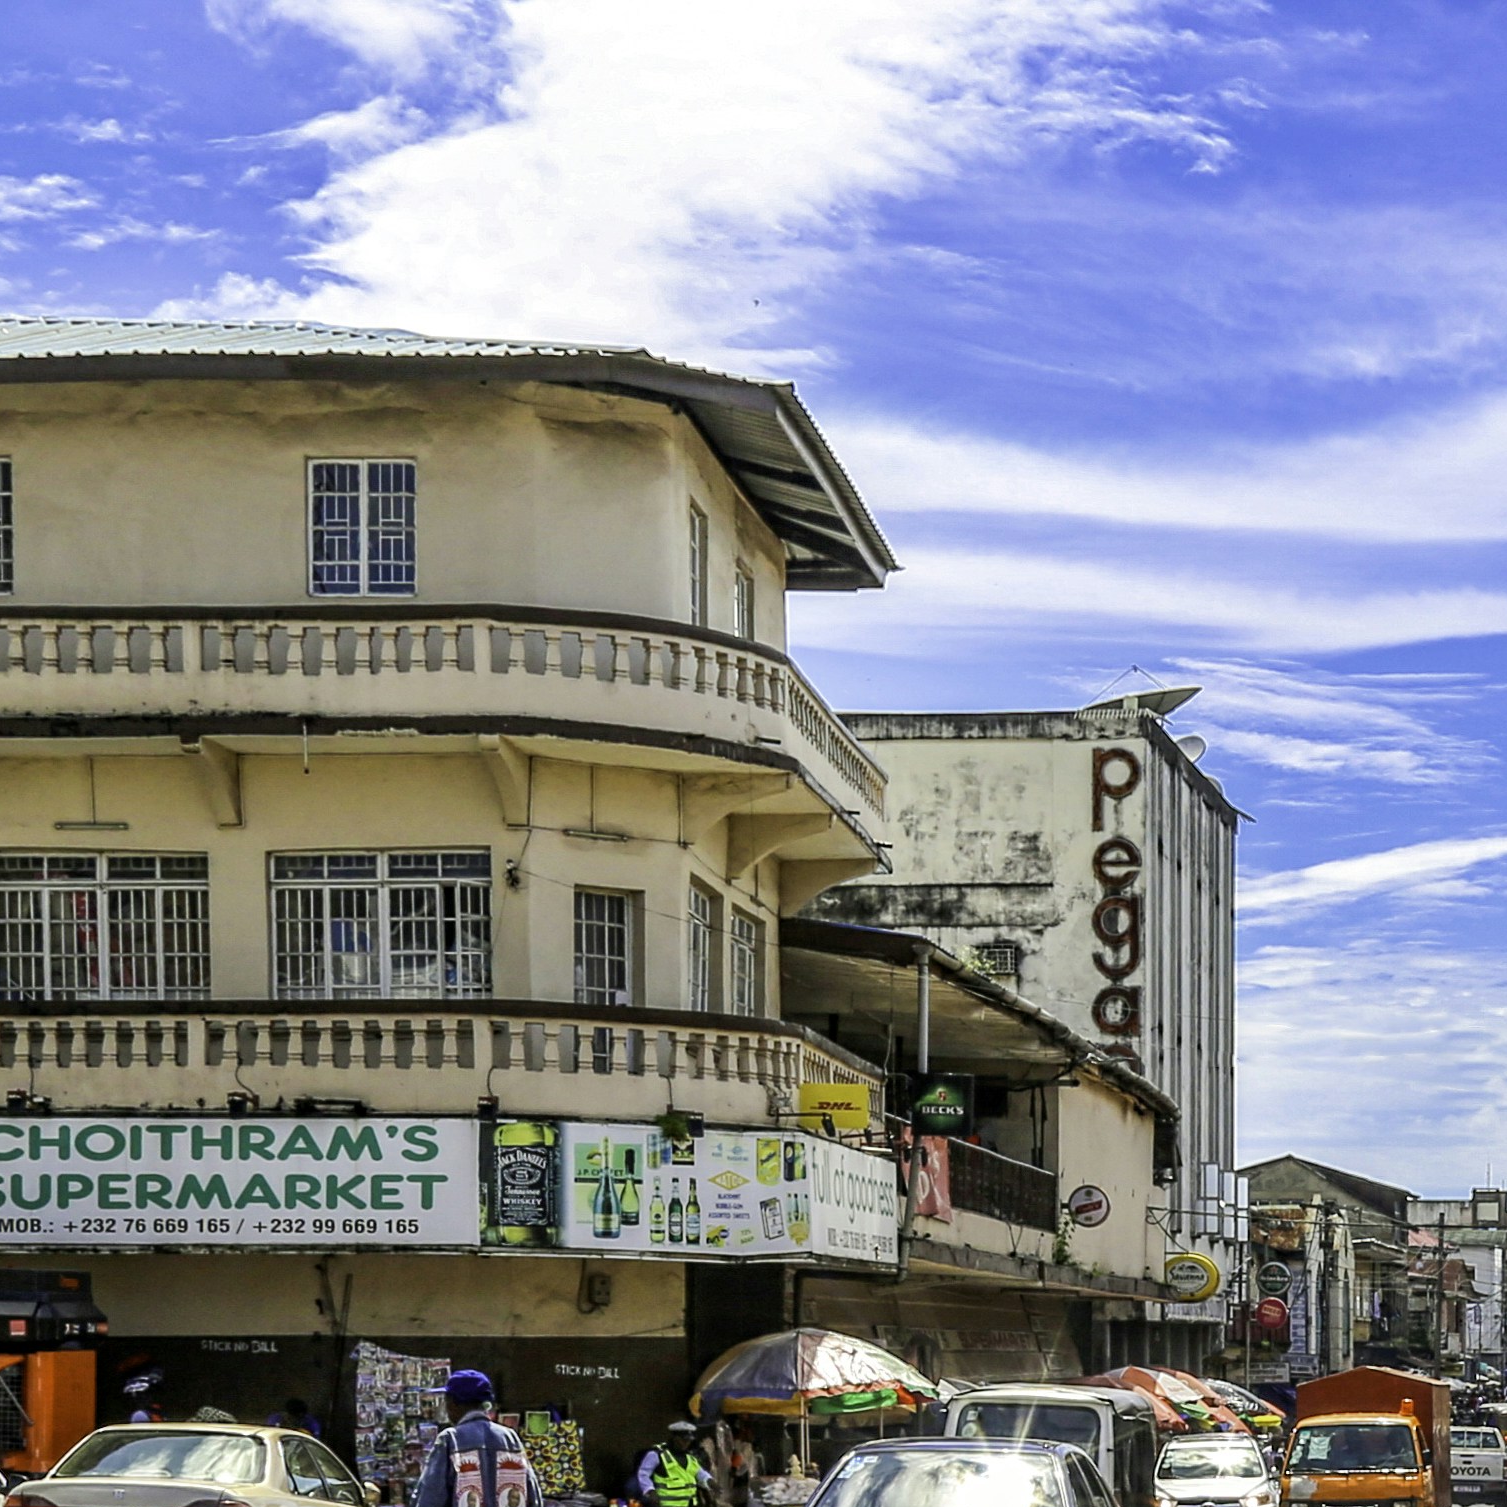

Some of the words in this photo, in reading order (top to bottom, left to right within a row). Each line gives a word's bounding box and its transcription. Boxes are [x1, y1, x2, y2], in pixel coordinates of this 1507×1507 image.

[817, 1101, 854, 1111] DHL
[922, 1105, 964, 1115] BECK'S
[62, 1217, 117, 1234] +232
[122, 1217, 147, 1234] 76
[153, 1217, 189, 1234] 669
[195, 1217, 231, 1234] 165
[252, 1217, 306, 1234] +232
[312, 1217, 336, 1234] 99
[342, 1217, 378, 1234] 669
[384, 1217, 419, 1234] 165
[555, 1364, 581, 1375] STICK
[1450, 1466, 1491, 1477] OYOTA
